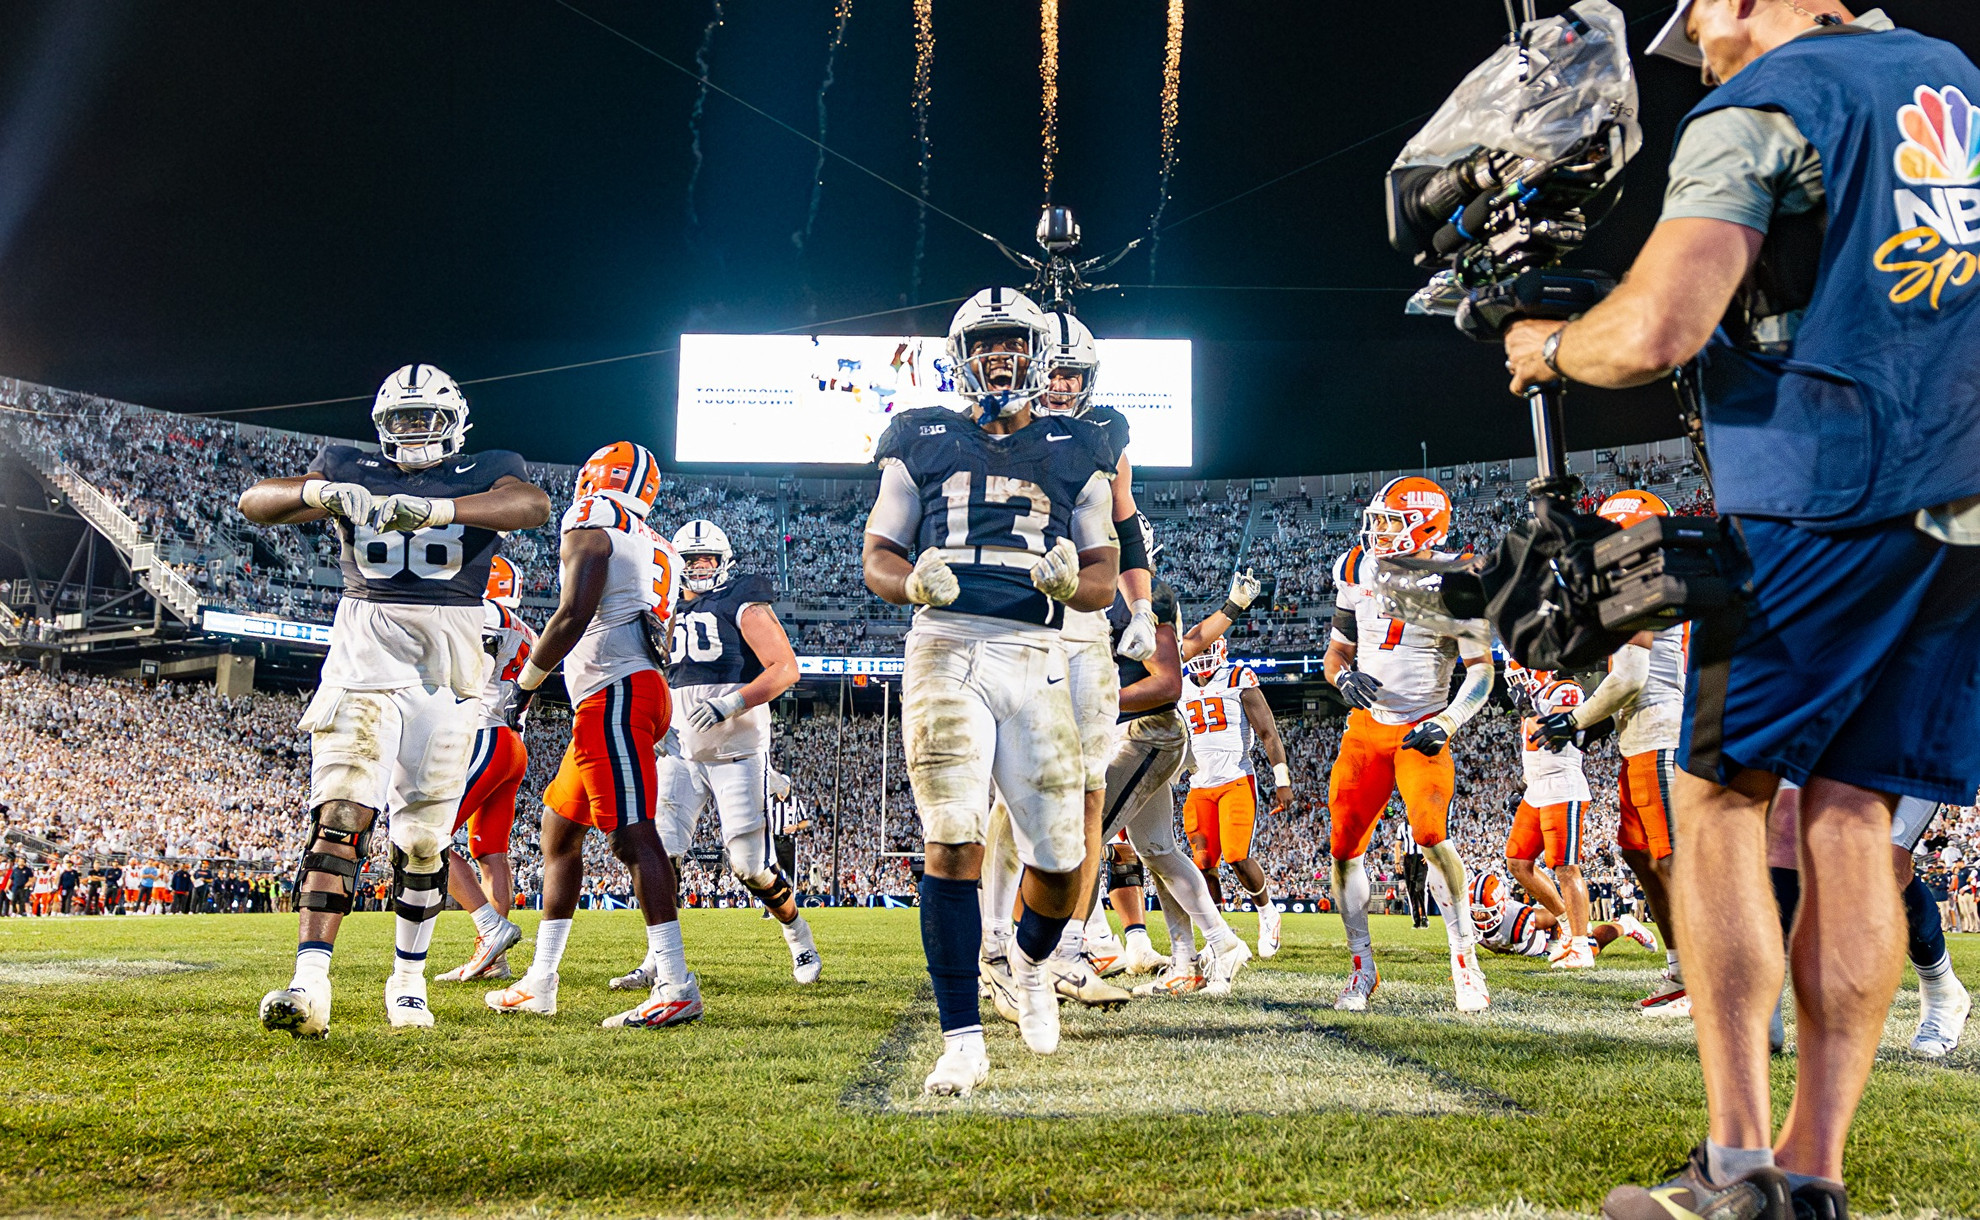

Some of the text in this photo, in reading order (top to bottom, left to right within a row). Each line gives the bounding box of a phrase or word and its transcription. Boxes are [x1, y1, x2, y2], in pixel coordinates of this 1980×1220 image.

[1873, 226, 1980, 310] Sp
[576, 499, 594, 523] 3
[1406, 491, 1445, 510] ILLINOIS
[1599, 498, 1642, 515] ILLINOIS
[940, 471, 1052, 570] 13
[652, 547, 672, 623] 3
[854, 675, 867, 687] 40
[1561, 690, 1580, 706] 28
[1186, 697, 1228, 735] 33
